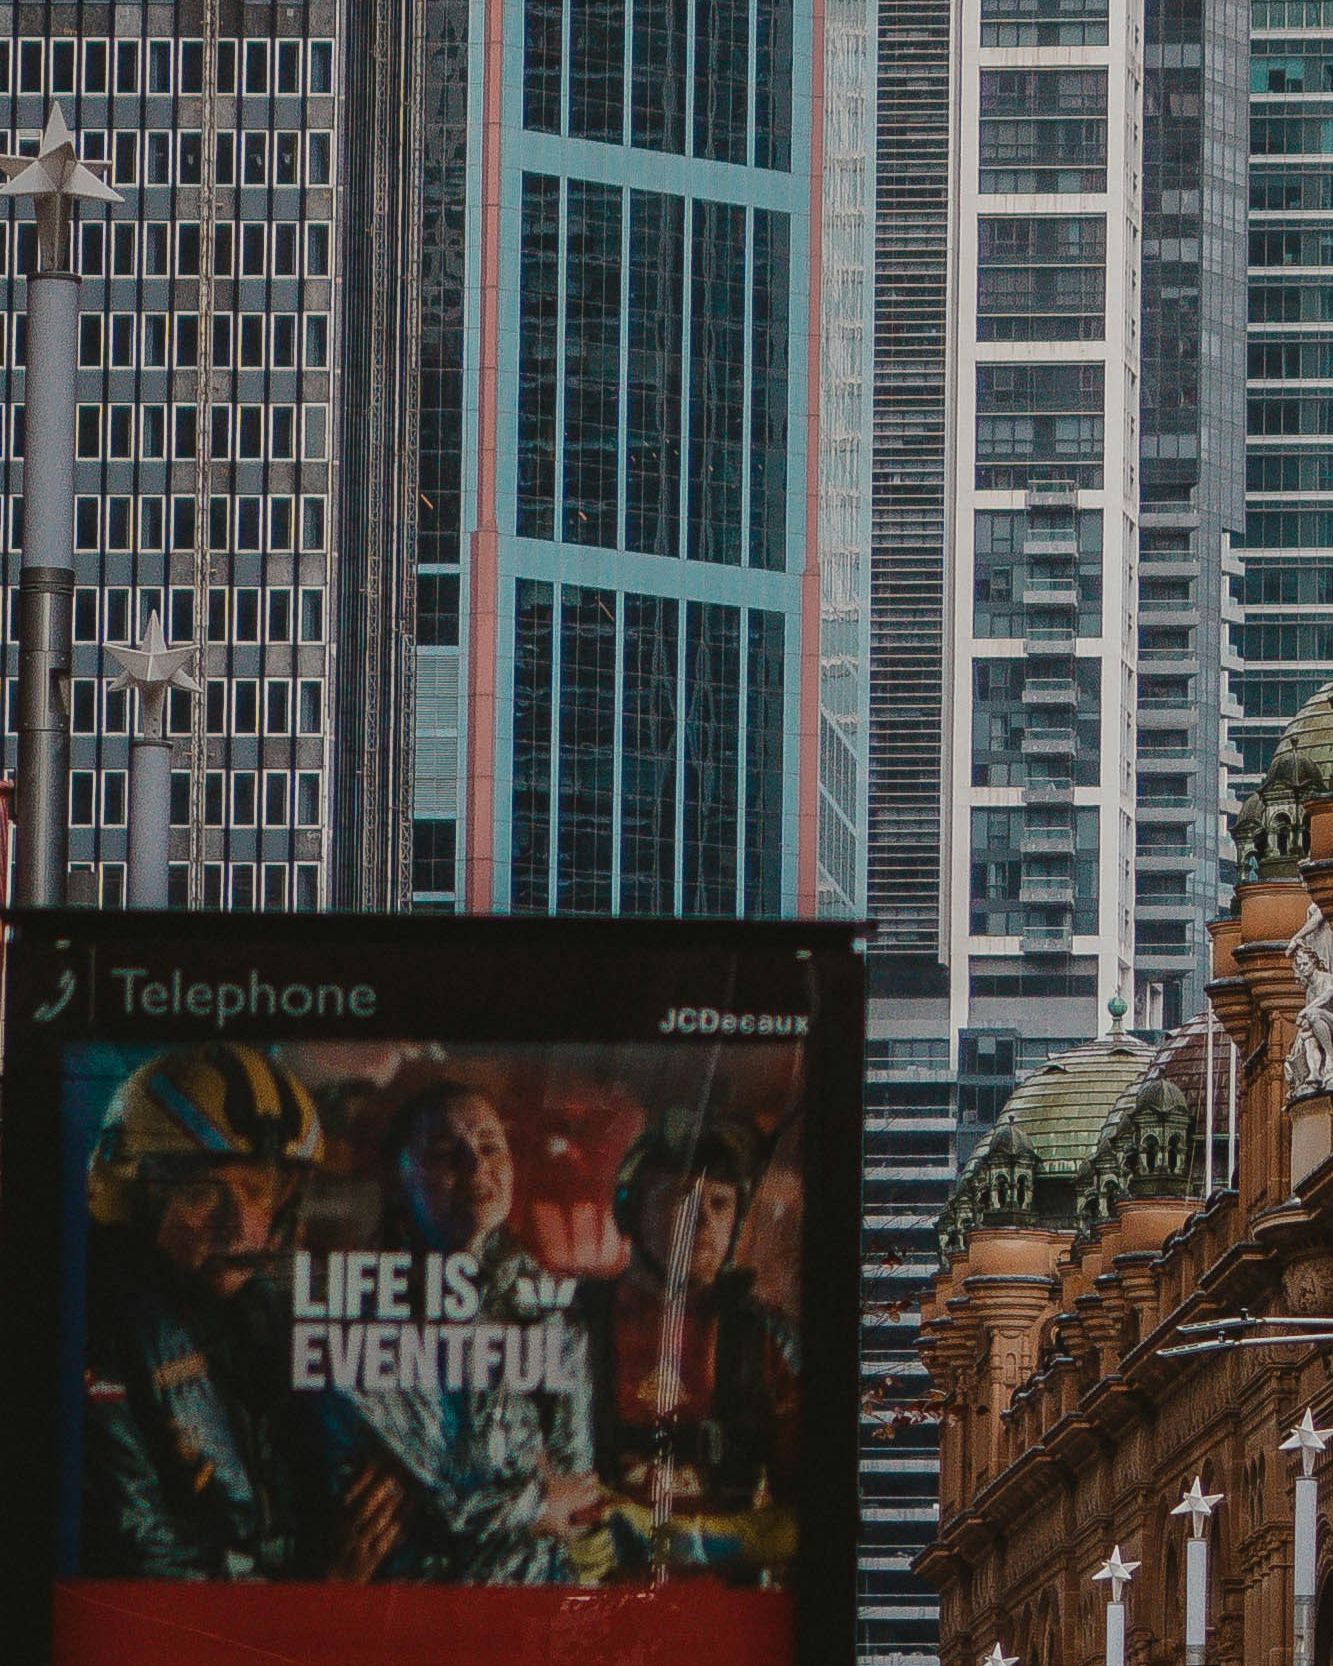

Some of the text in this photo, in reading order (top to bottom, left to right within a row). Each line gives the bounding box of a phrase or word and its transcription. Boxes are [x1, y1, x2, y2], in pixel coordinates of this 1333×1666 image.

[112, 967, 378, 1027] Telephone
[658, 1009, 811, 1035] JCDecaux
[291, 1250, 481, 1322] LIFE IS
[290, 1324, 584, 1394] EVENTFUL
